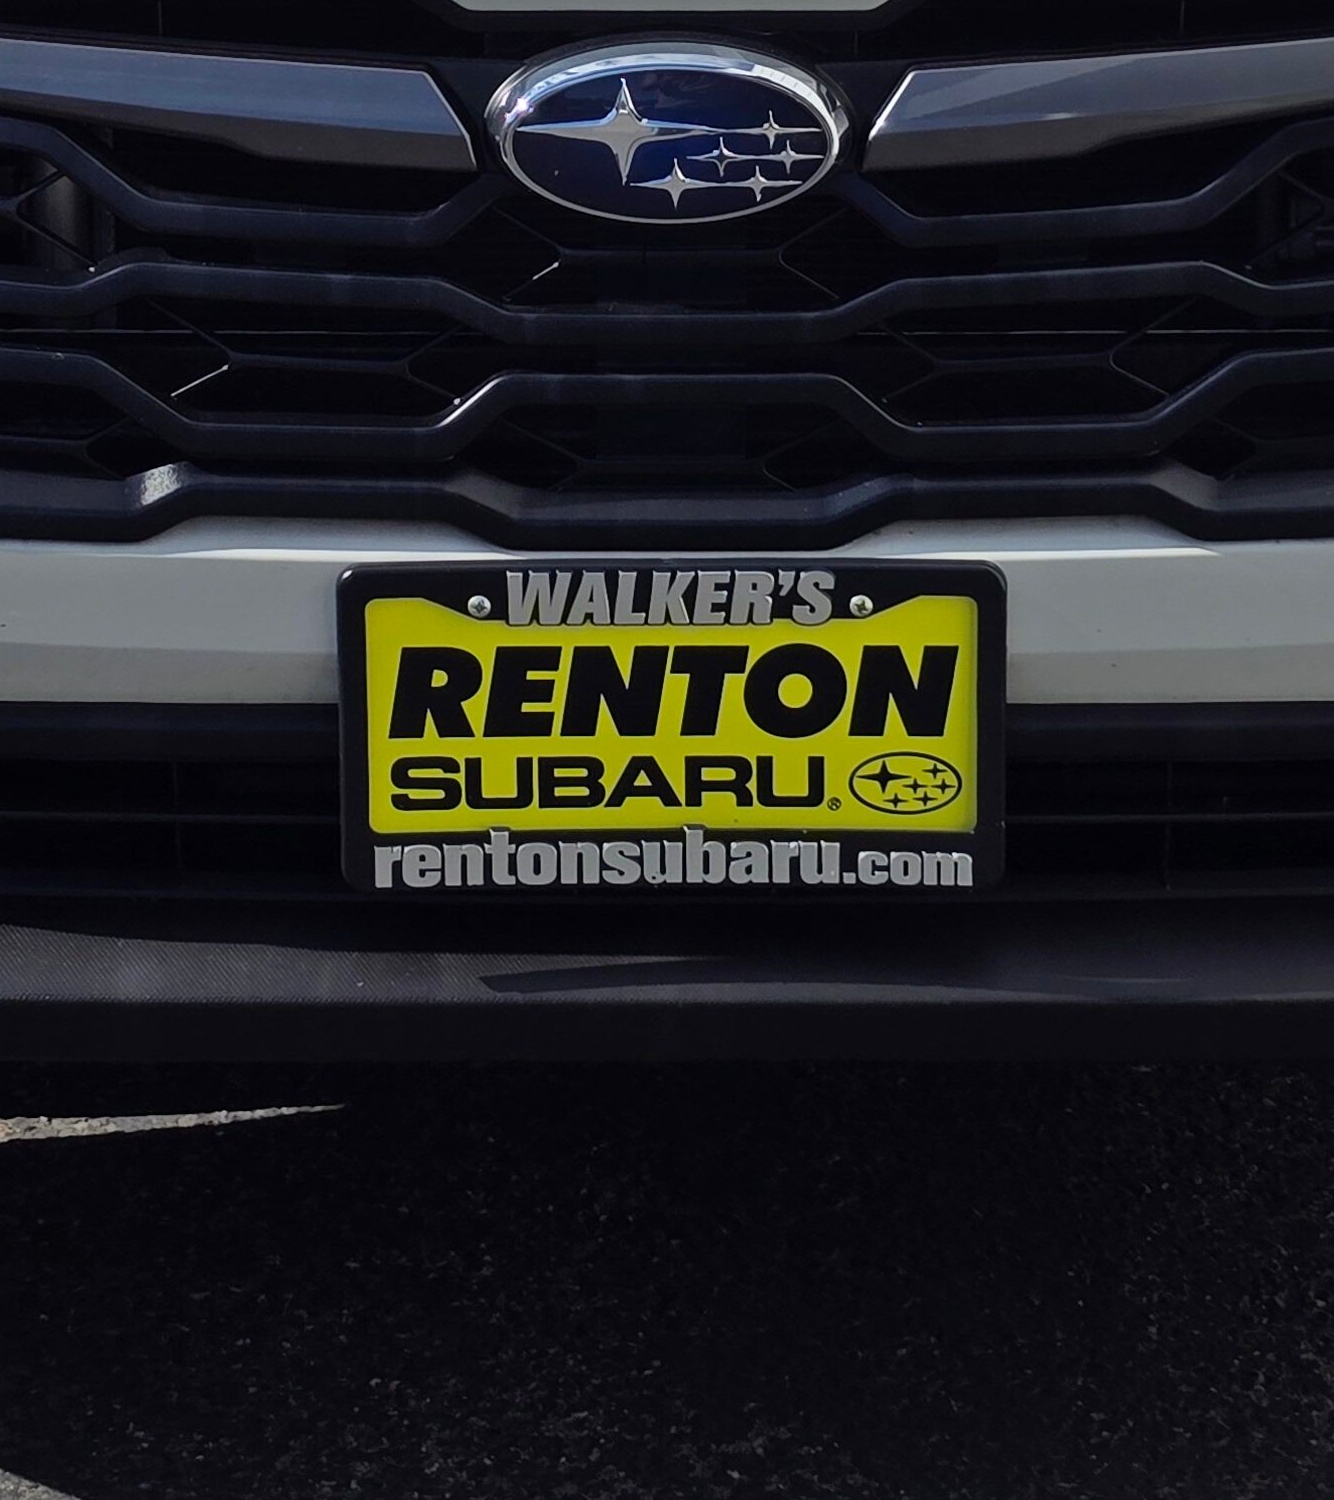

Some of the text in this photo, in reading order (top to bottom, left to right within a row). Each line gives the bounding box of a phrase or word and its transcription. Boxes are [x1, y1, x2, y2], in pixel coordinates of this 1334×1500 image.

[505, 569, 835, 626] WALKER'S
[387, 642, 960, 740] RENTON
[389, 755, 827, 812] SUBARU
[373, 825, 975, 890] rentonsubaru.com
